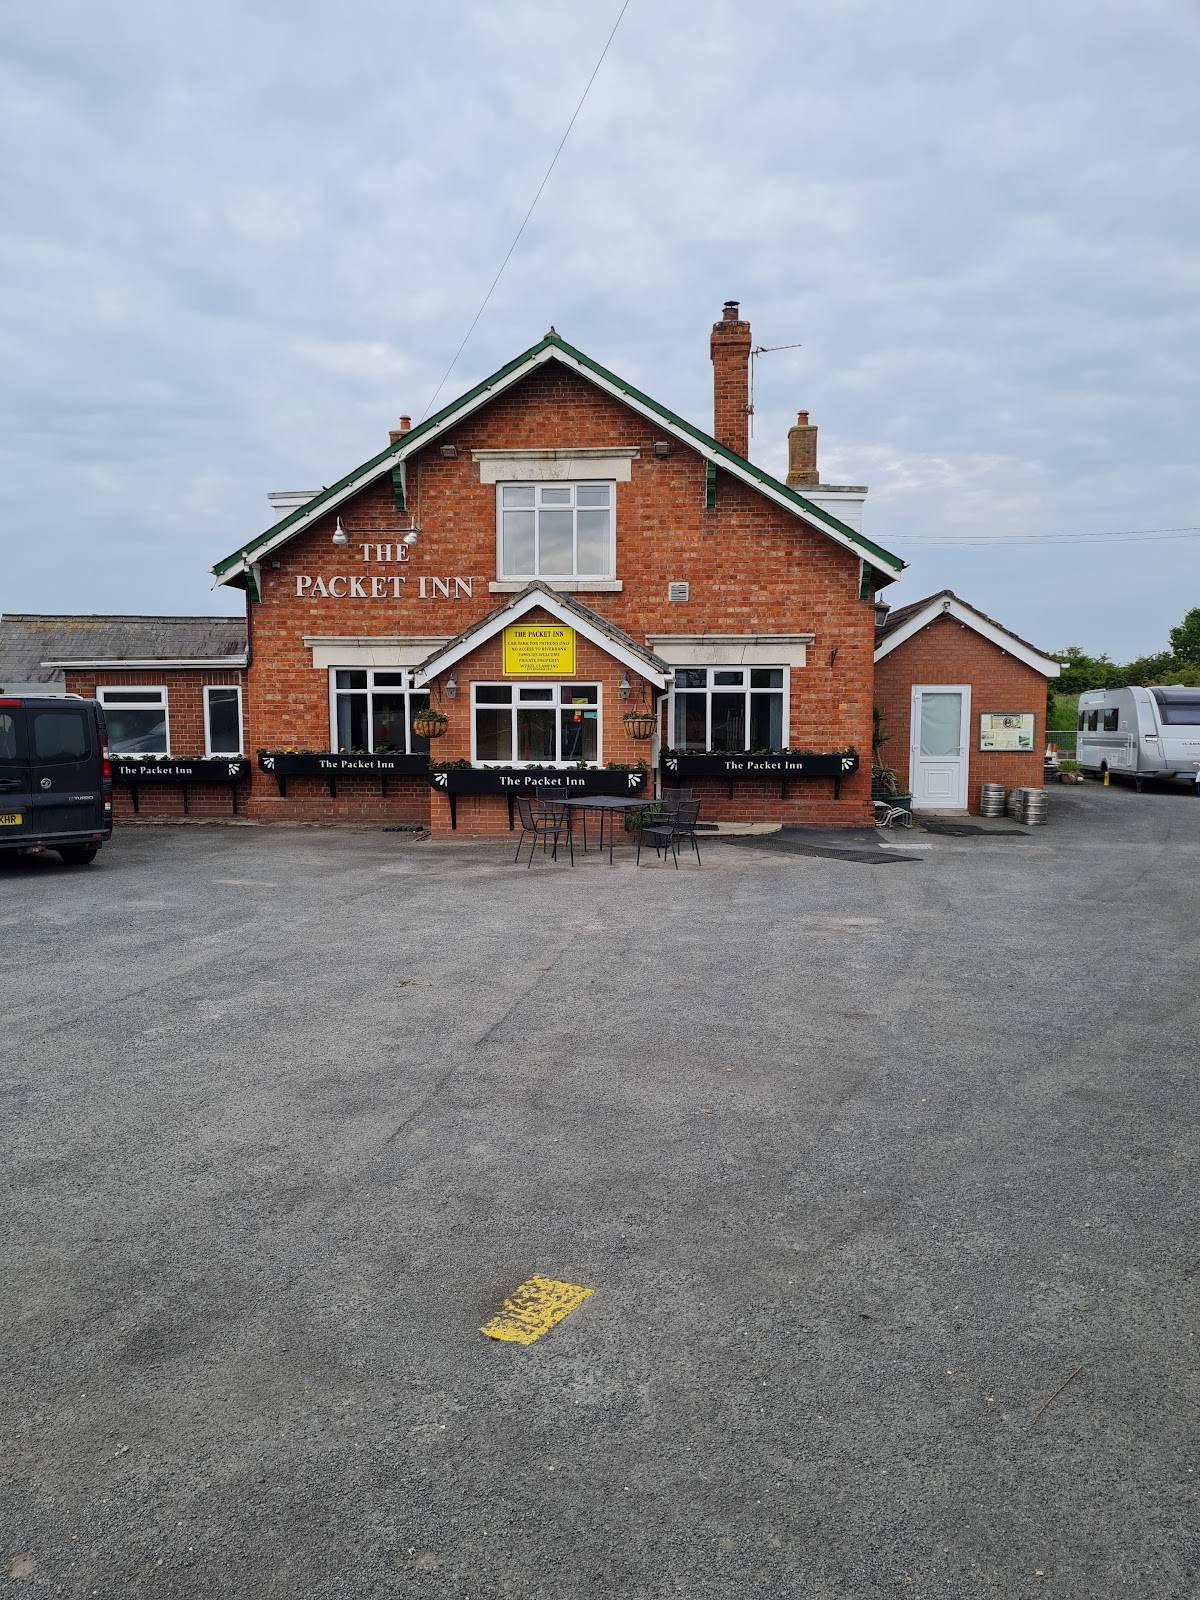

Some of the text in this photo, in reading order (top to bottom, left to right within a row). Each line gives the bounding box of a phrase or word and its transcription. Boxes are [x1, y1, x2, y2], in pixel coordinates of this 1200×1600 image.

[359, 543, 410, 562] THE
[294, 575, 475, 599] PACKET INN
[319, 760, 395, 769] The Packet Inn
[724, 761, 803, 770] The Packet Inn
[119, 766, 193, 775] The Packet Inn
[499, 776, 585, 786] The Packet Inn
